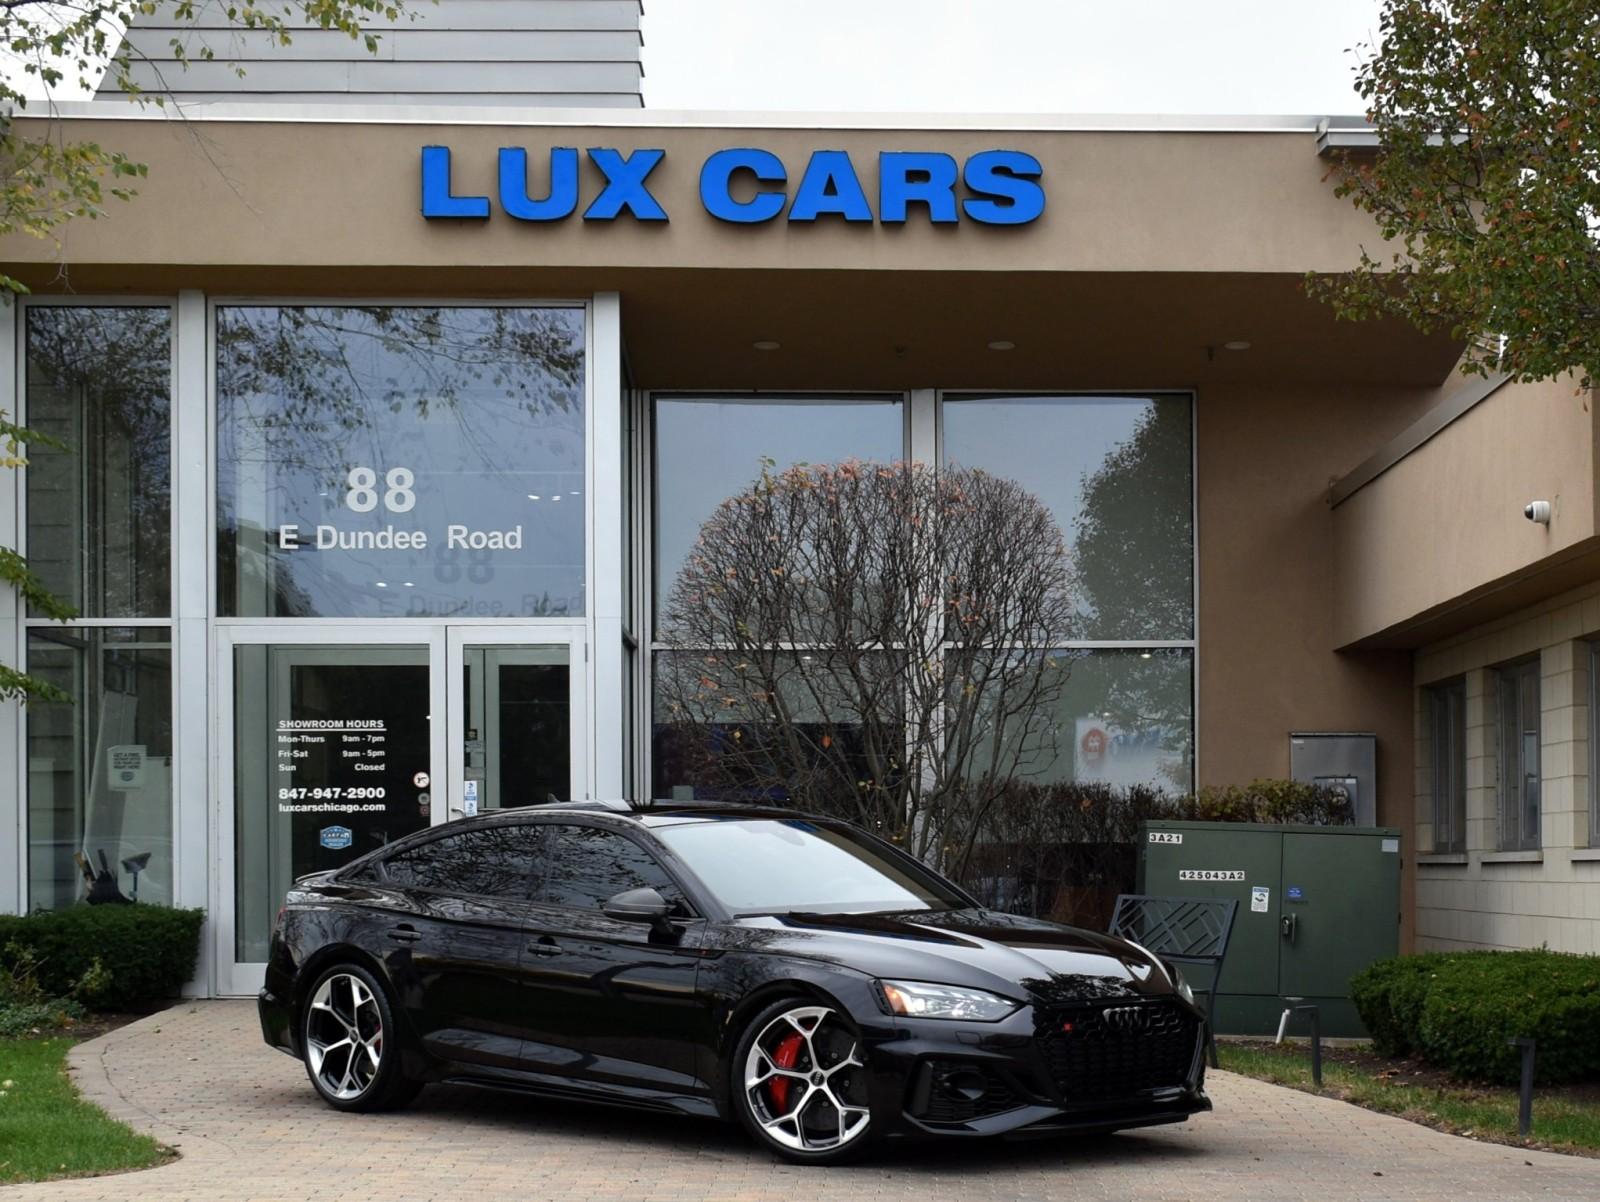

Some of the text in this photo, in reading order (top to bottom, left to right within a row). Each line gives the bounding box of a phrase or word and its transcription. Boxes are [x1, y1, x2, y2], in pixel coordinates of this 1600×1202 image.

[421, 145, 1046, 225] LUX CARS
[346, 467, 417, 513] 88
[279, 525, 523, 550] E Dundee Road
[279, 720, 385, 728] SHOWROOM HOURS
[278, 735, 325, 743] Mon-Thurs
[278, 750, 308, 758] Fri-Sat
[354, 763, 385, 771] Closed
[279, 787, 386, 799] 847-947-2900
[279, 803, 386, 813] luxcarschicago.com
[1149, 834, 1181, 843] 3A21
[1180, 871, 1245, 880] 425043A2
